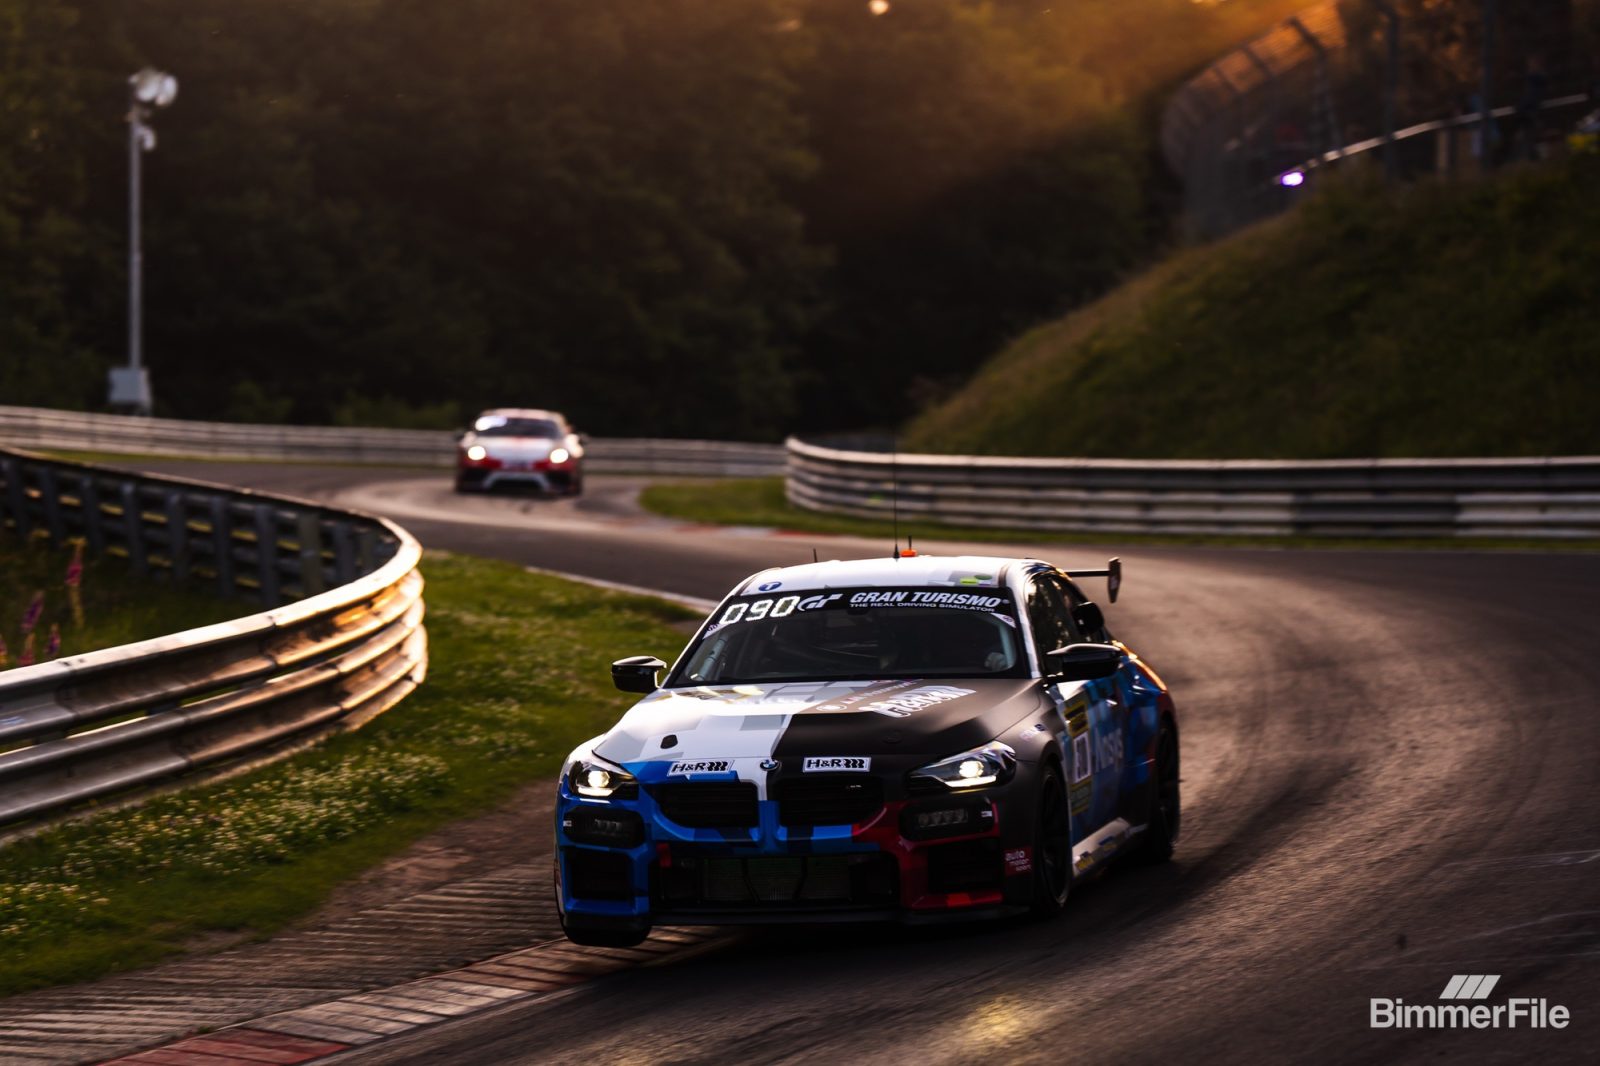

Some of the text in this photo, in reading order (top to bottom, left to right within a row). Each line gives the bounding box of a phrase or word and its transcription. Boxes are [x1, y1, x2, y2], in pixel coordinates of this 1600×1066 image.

[850, 592, 1002, 608] GRAN TURISMO
[939, 603, 995, 613] SIMULATOR
[718, 596, 801, 625] 090
